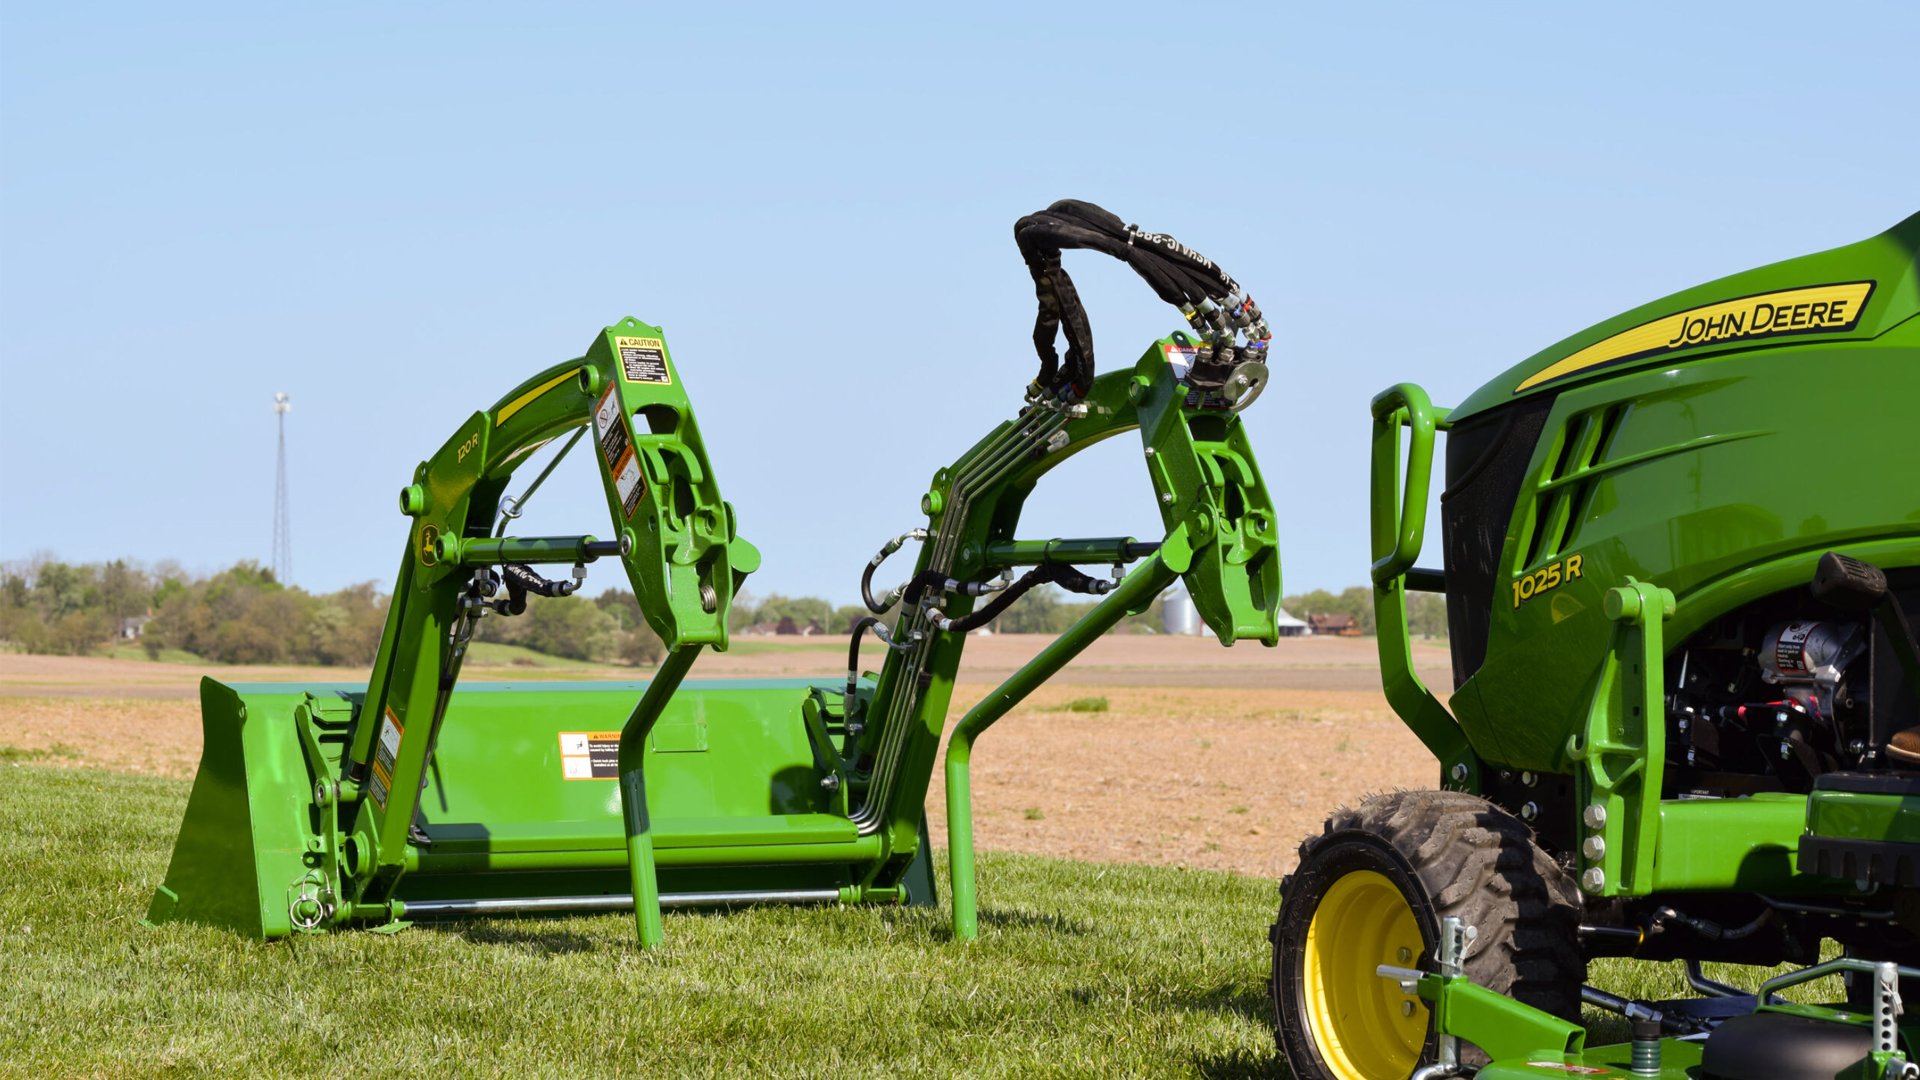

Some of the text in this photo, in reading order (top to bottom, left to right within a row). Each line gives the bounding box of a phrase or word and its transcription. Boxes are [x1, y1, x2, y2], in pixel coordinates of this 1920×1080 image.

[1669, 300, 1848, 345] JOHN DEERE
[628, 338, 660, 347] CAUTION
[457, 441, 472, 464] 120
[1512, 554, 1584, 609] 1025 R
